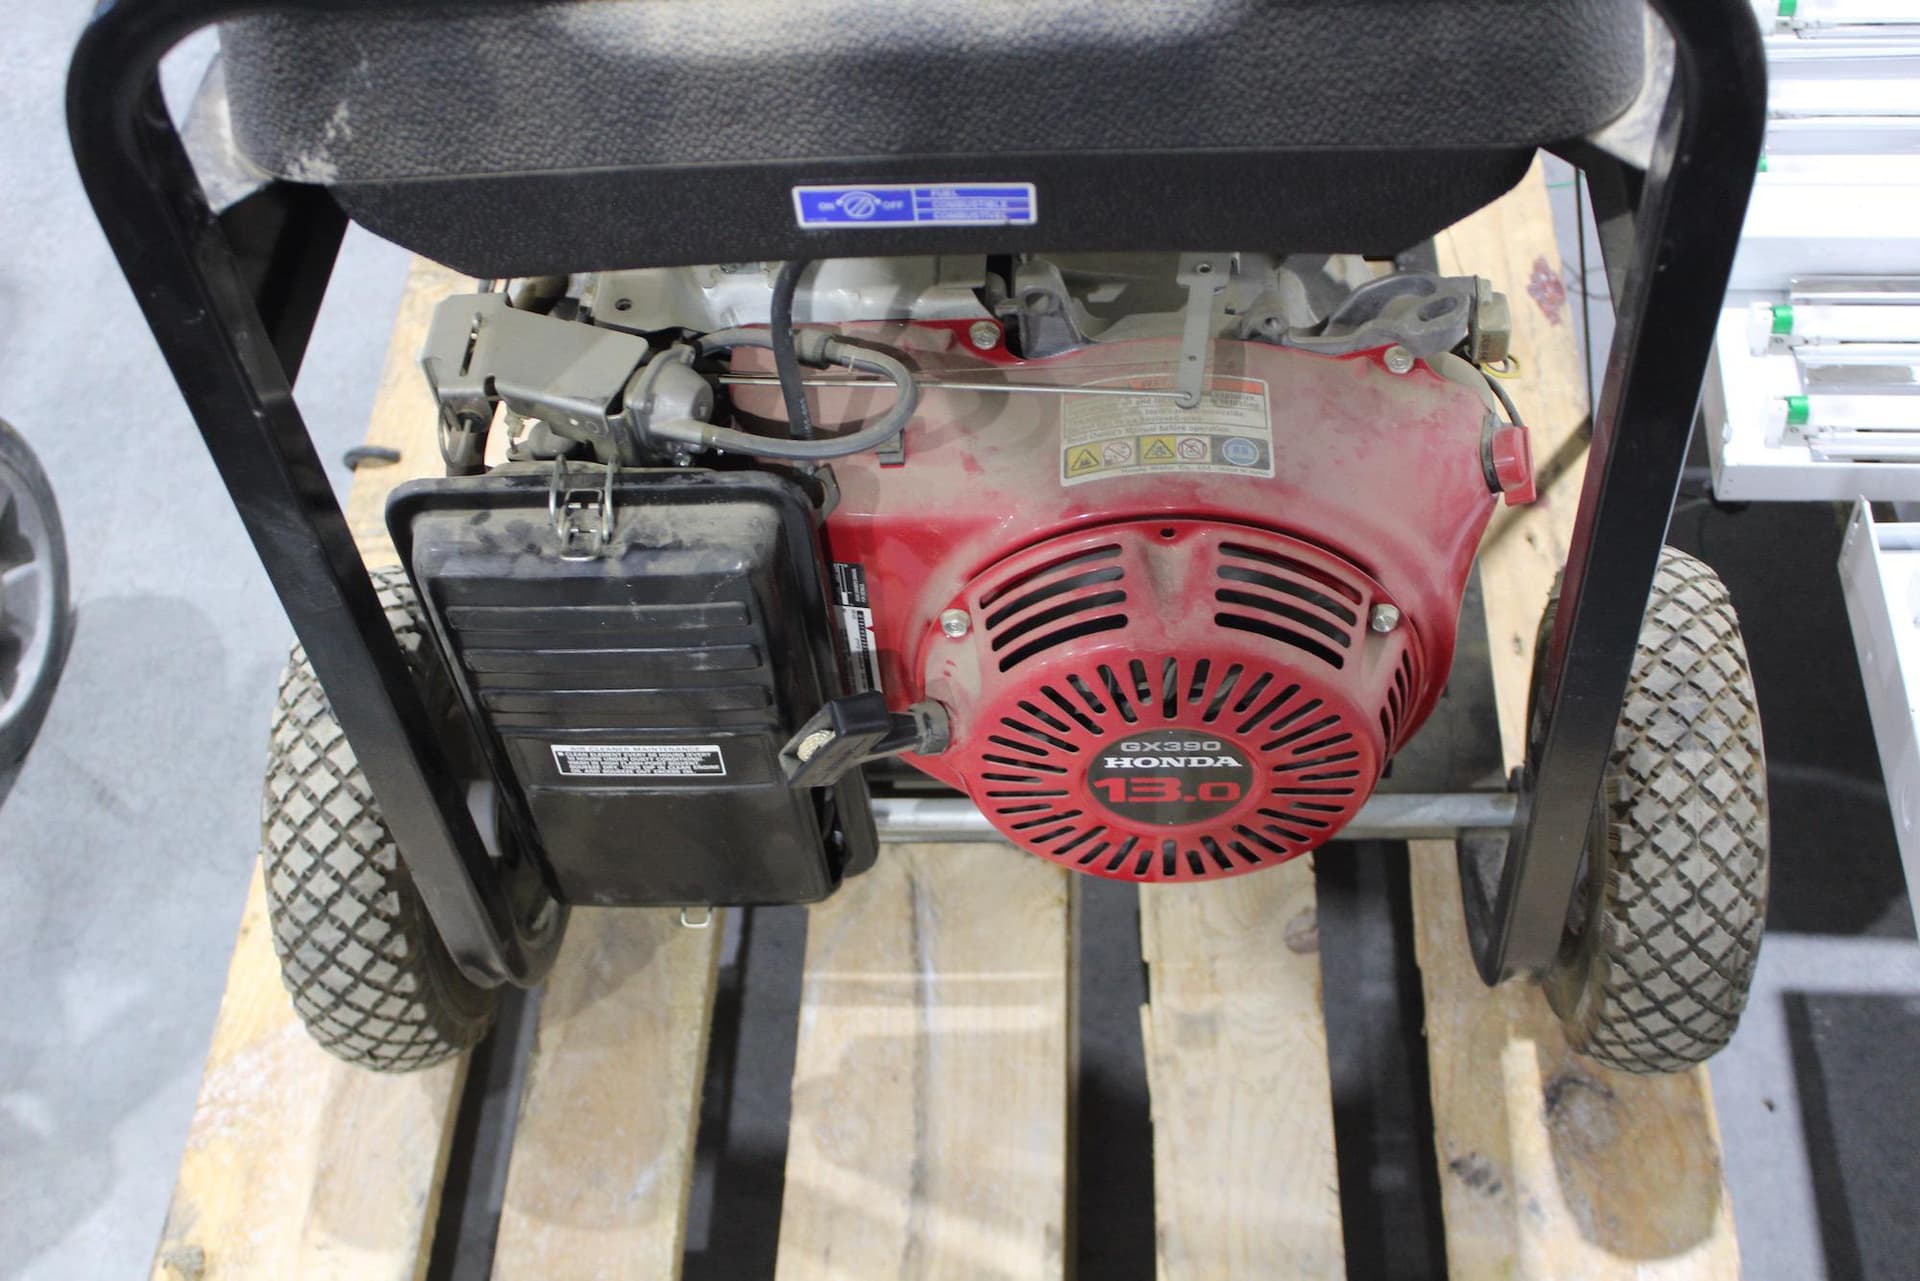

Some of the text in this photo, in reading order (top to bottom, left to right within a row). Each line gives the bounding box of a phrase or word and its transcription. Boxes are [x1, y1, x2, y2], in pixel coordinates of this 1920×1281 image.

[818, 200, 903, 211] ON OFF
[1120, 741, 1222, 752] GX390
[1103, 756, 1243, 768] HONDA
[1094, 777, 1240, 803] 13.0
